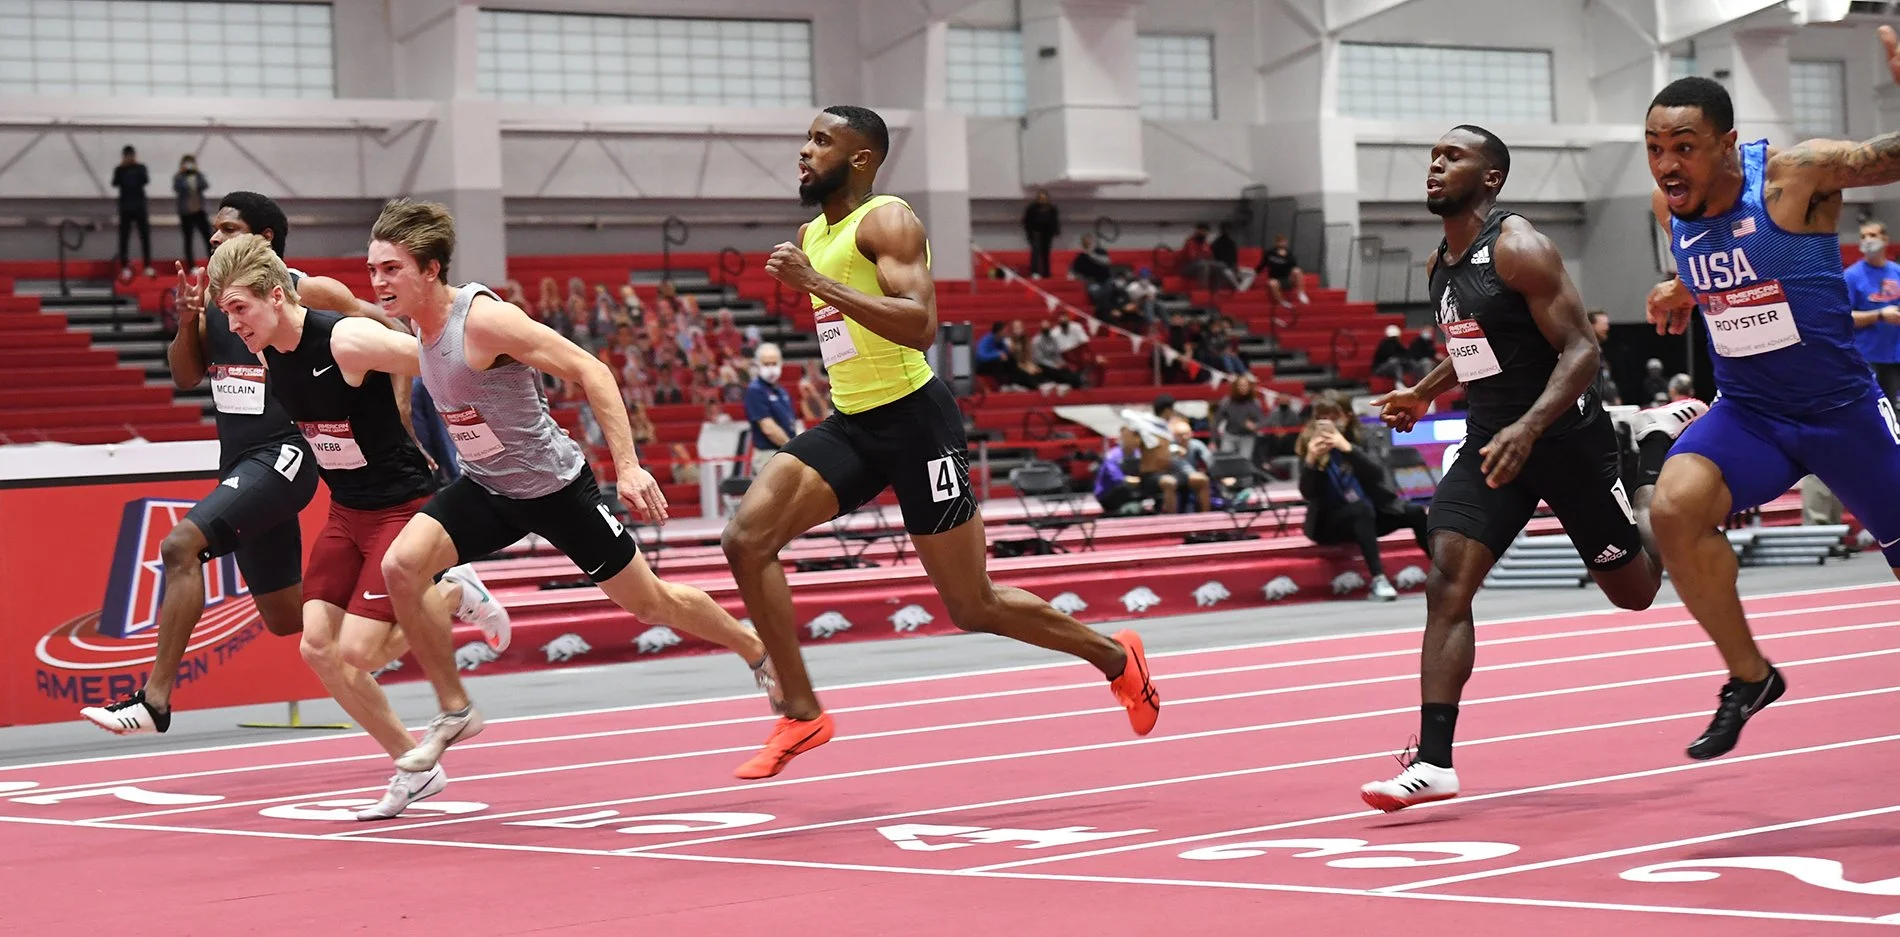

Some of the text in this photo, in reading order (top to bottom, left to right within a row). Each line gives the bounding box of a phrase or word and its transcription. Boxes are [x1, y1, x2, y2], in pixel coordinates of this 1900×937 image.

[1688, 248, 1757, 290] USA
[1715, 310, 1779, 331] ROYSTER
[1450, 345, 1479, 357] FRASER
[217, 385, 256, 394] MCCLAIN
[315, 443, 341, 452] WEBB
[281, 447, 300, 473] 7
[936, 460, 954, 496] 4
[1594, 549, 1627, 563] adidas
[502, 810, 776, 834] 5
[875, 823, 1157, 851] 4
[1178, 838, 1520, 869] 3
